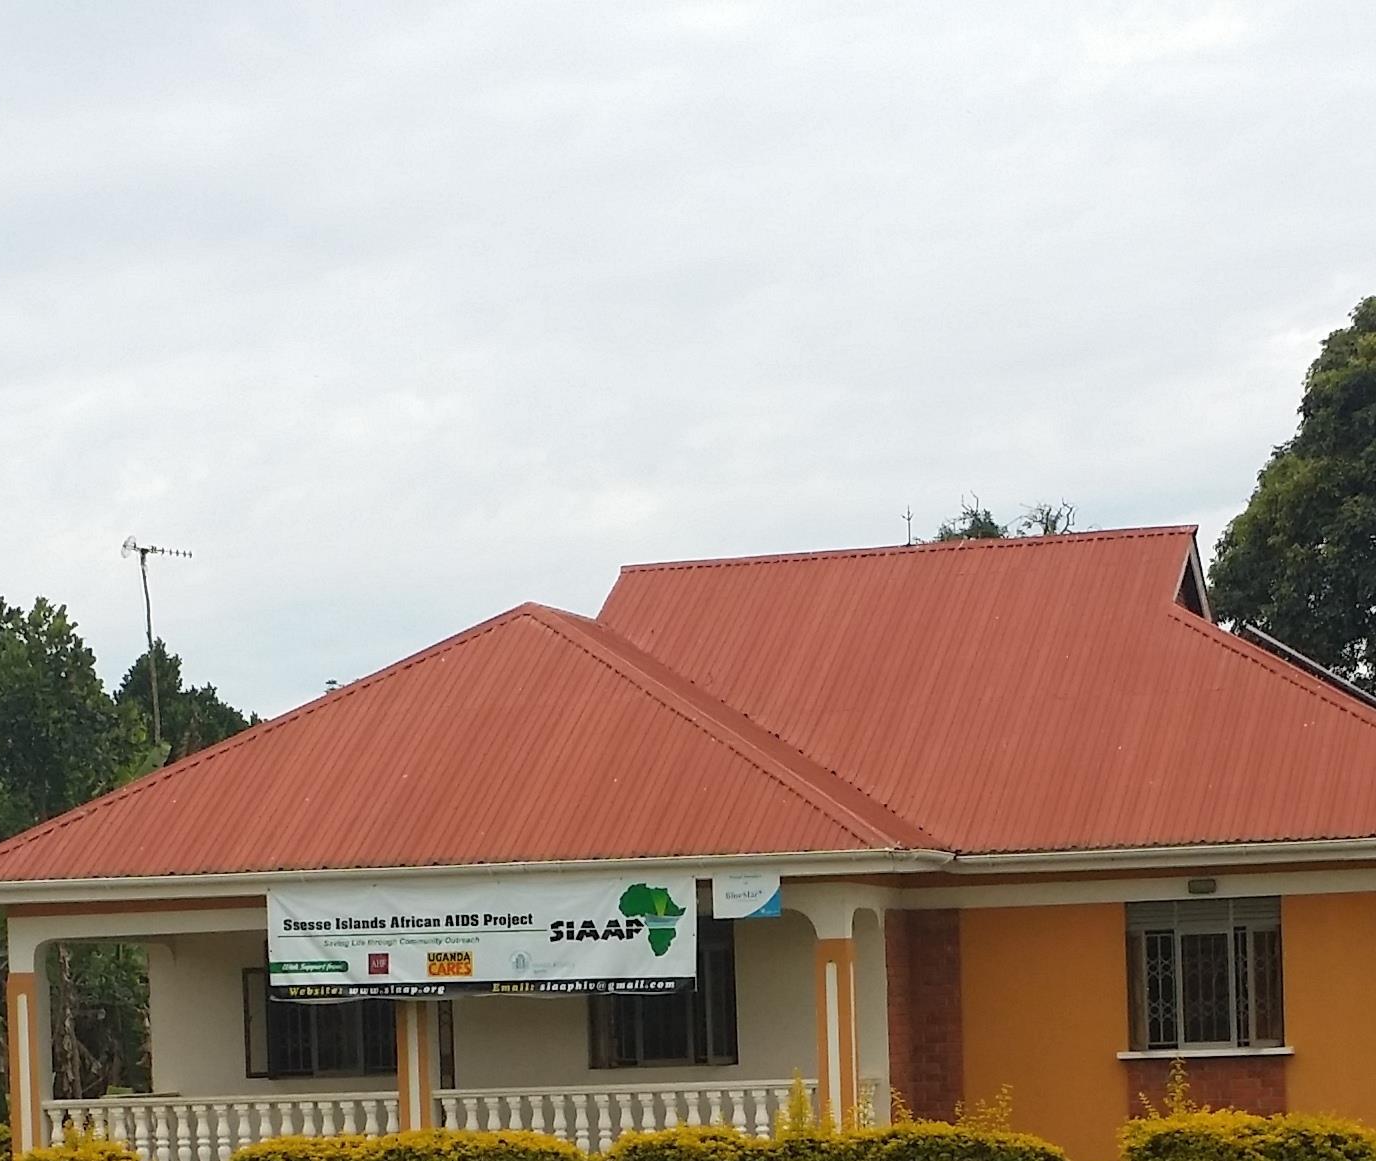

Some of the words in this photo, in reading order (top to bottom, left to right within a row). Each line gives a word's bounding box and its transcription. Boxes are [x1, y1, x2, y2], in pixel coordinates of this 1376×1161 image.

[283, 919, 332, 931] Ssesse
[335, 917, 387, 930] Islands
[390, 915, 441, 928] African
[444, 914, 480, 927] AIDS
[483, 913, 534, 928] Project
[550, 919, 645, 942] SIAAP
[427, 952, 471, 962] UGANDA
[428, 962, 472, 976] CARES
[288, 986, 344, 997] Website:
[492, 982, 535, 992] Email:
